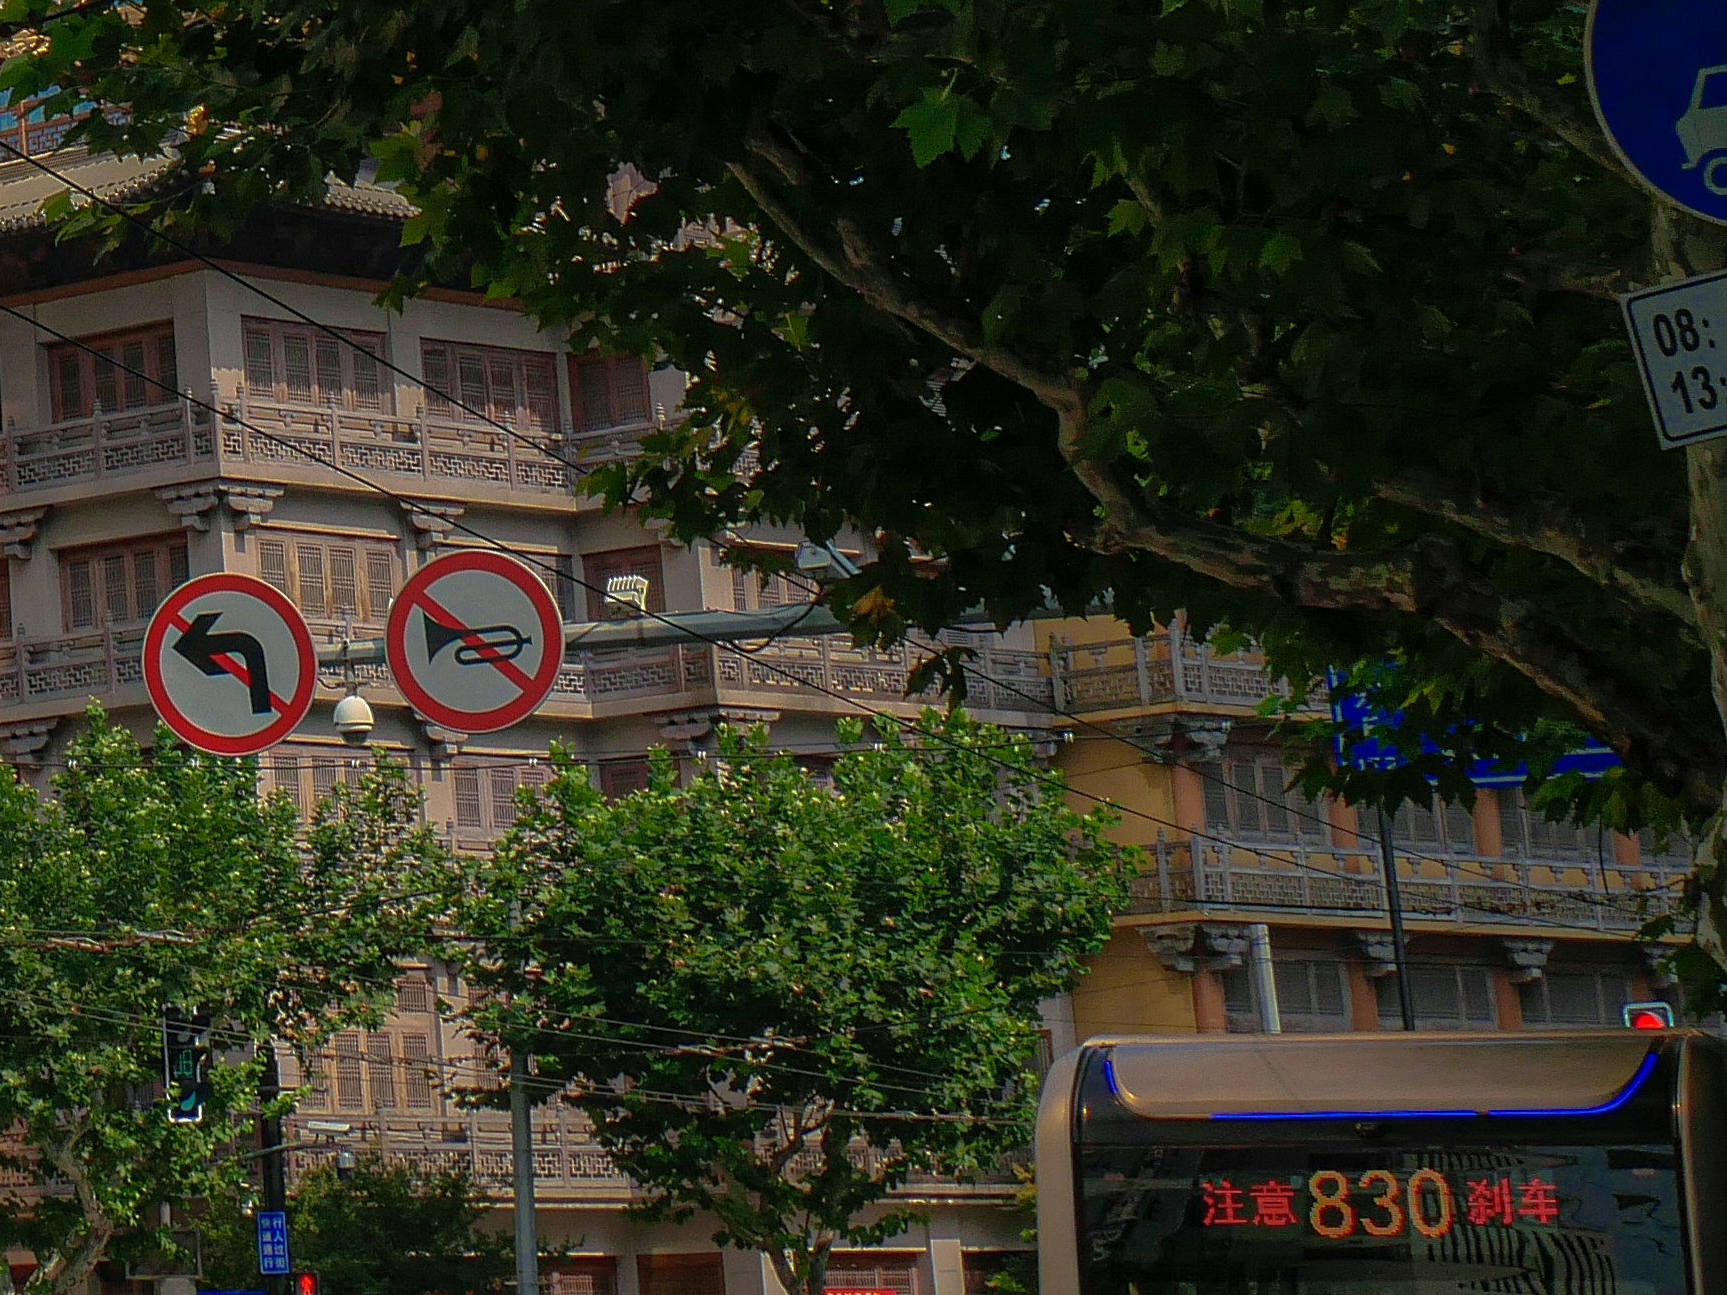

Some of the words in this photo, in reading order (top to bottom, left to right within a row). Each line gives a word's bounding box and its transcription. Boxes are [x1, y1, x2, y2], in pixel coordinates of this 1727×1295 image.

[1201, 1179, 1297, 1226] 注意
[1308, 1167, 1454, 1239] 830
[1467, 1177, 1560, 1226] 刹车
